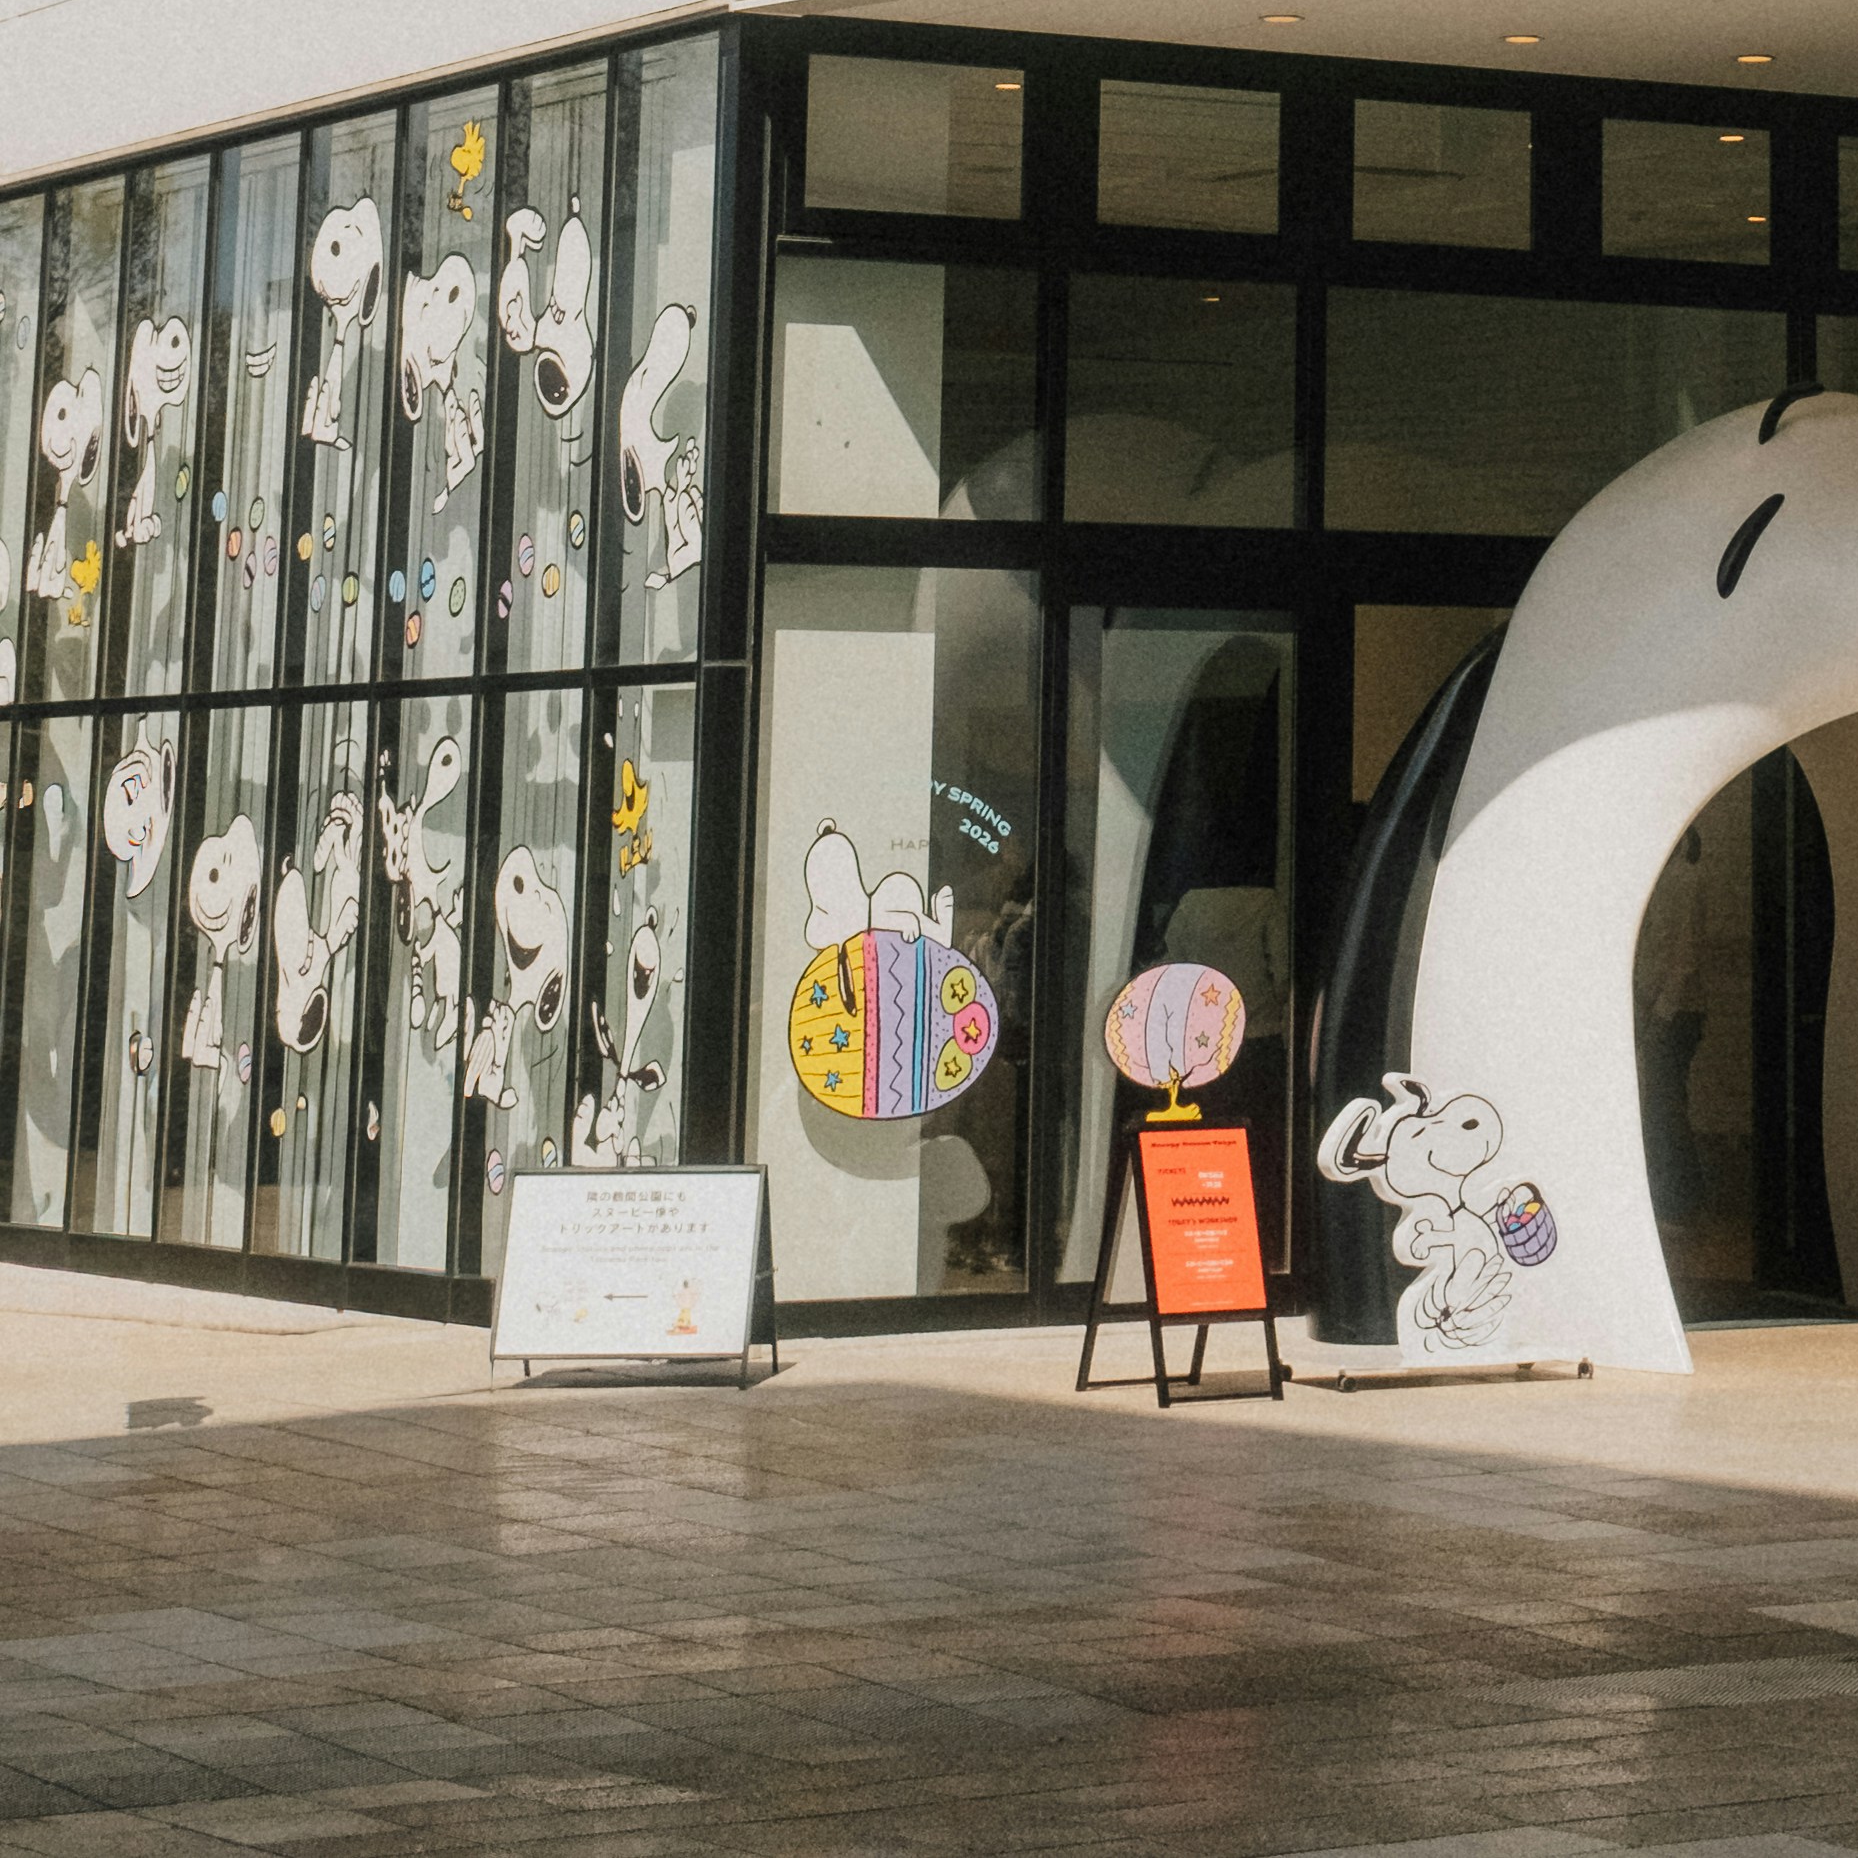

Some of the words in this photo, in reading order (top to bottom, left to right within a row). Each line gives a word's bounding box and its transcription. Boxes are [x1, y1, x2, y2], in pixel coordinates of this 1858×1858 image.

[947, 786, 1012, 837] SPRING
[958, 818, 1000, 854] 2026
[560, 1223, 710, 1234] トリックアートがあります
